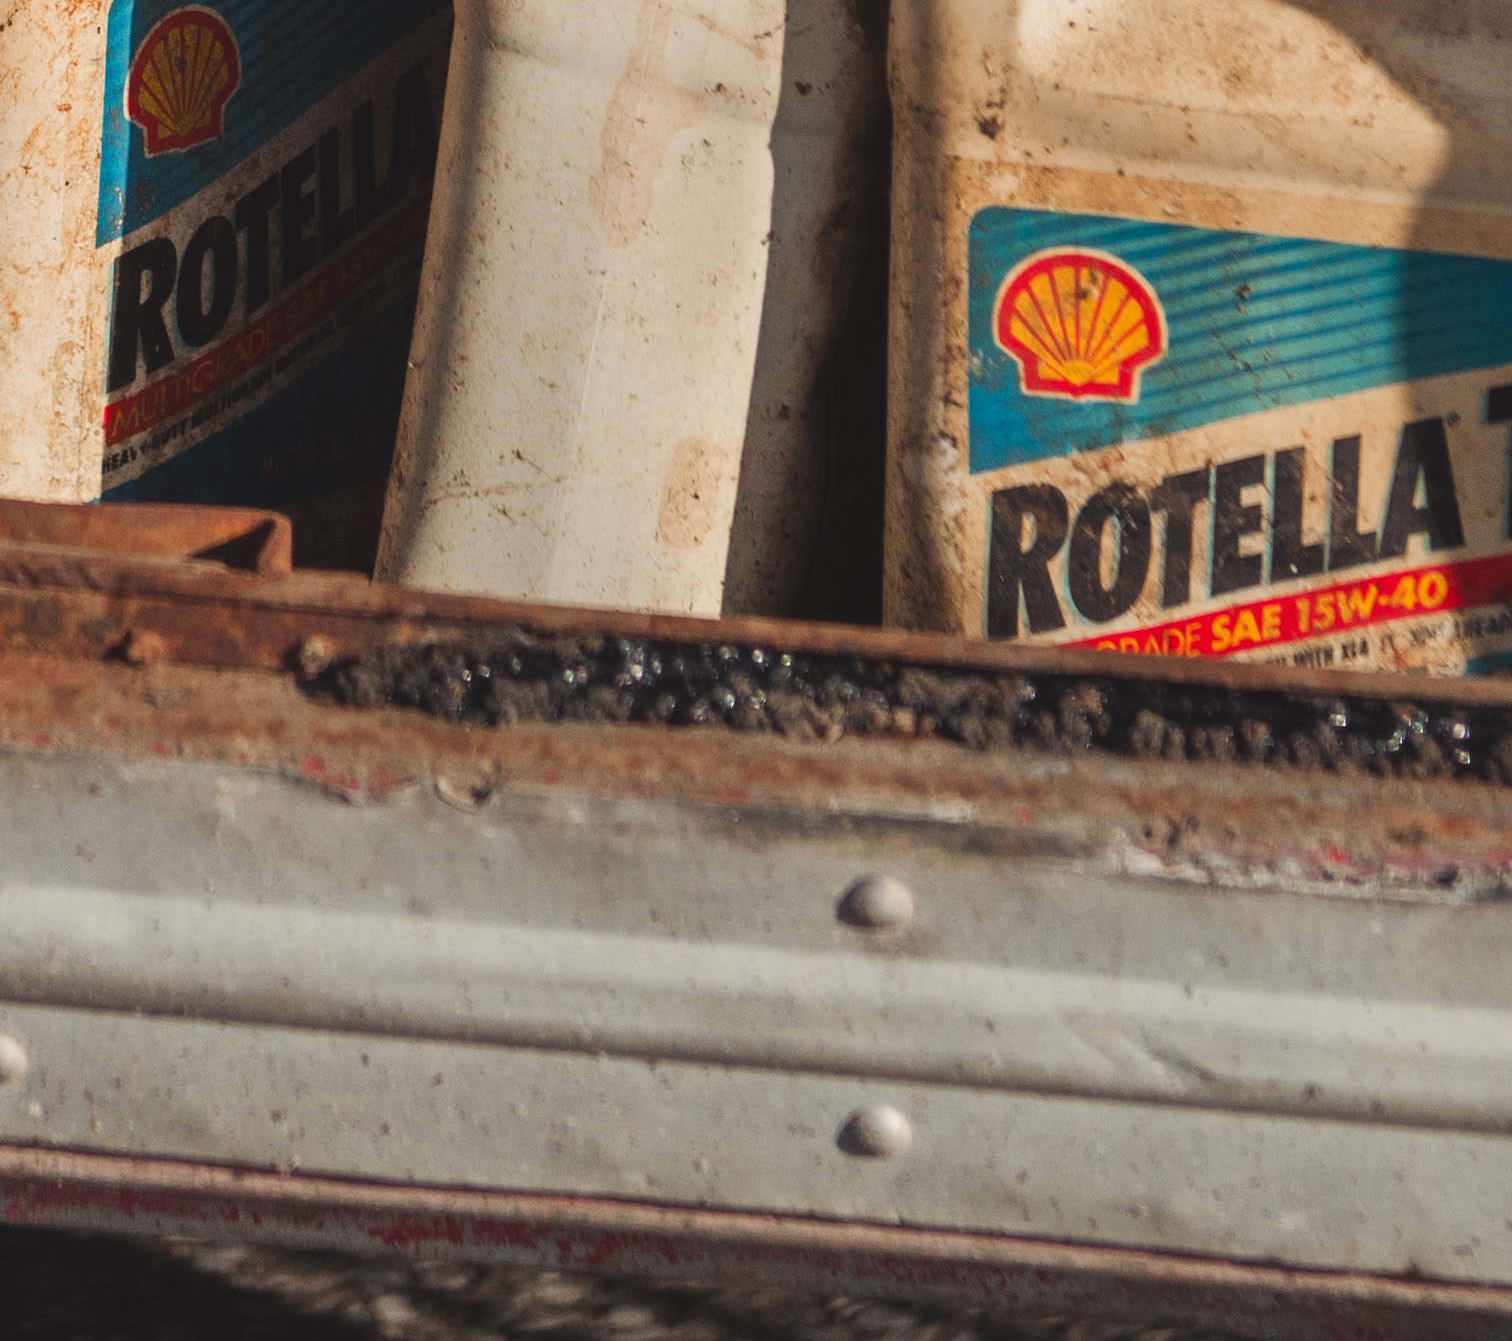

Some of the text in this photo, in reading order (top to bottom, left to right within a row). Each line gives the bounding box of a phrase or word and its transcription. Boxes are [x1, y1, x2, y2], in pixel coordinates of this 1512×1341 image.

[106, 63, 440, 394] ROTELLA
[111, 318, 278, 439] MULTIGRADE
[986, 417, 1466, 640] ROTELLA
[1095, 571, 1449, 658] ADE SAE 15W-40
